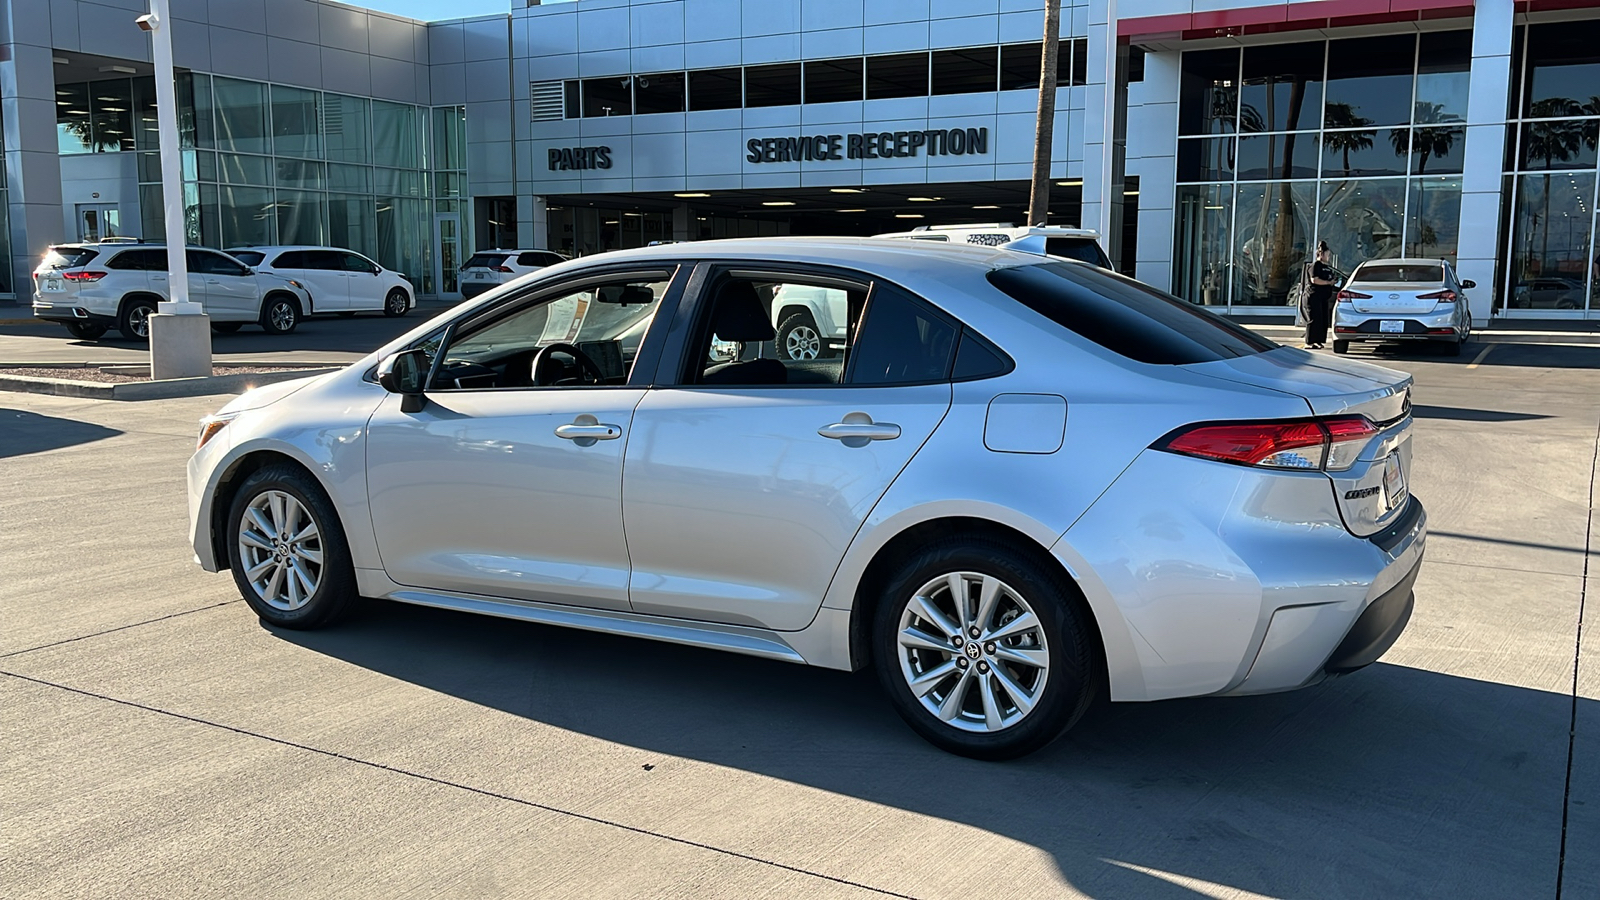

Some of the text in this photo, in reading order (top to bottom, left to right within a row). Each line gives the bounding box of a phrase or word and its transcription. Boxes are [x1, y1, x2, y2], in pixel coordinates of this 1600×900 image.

[548, 146, 612, 170] PARTS
[747, 127, 988, 163] SERVICE RECEPTION
